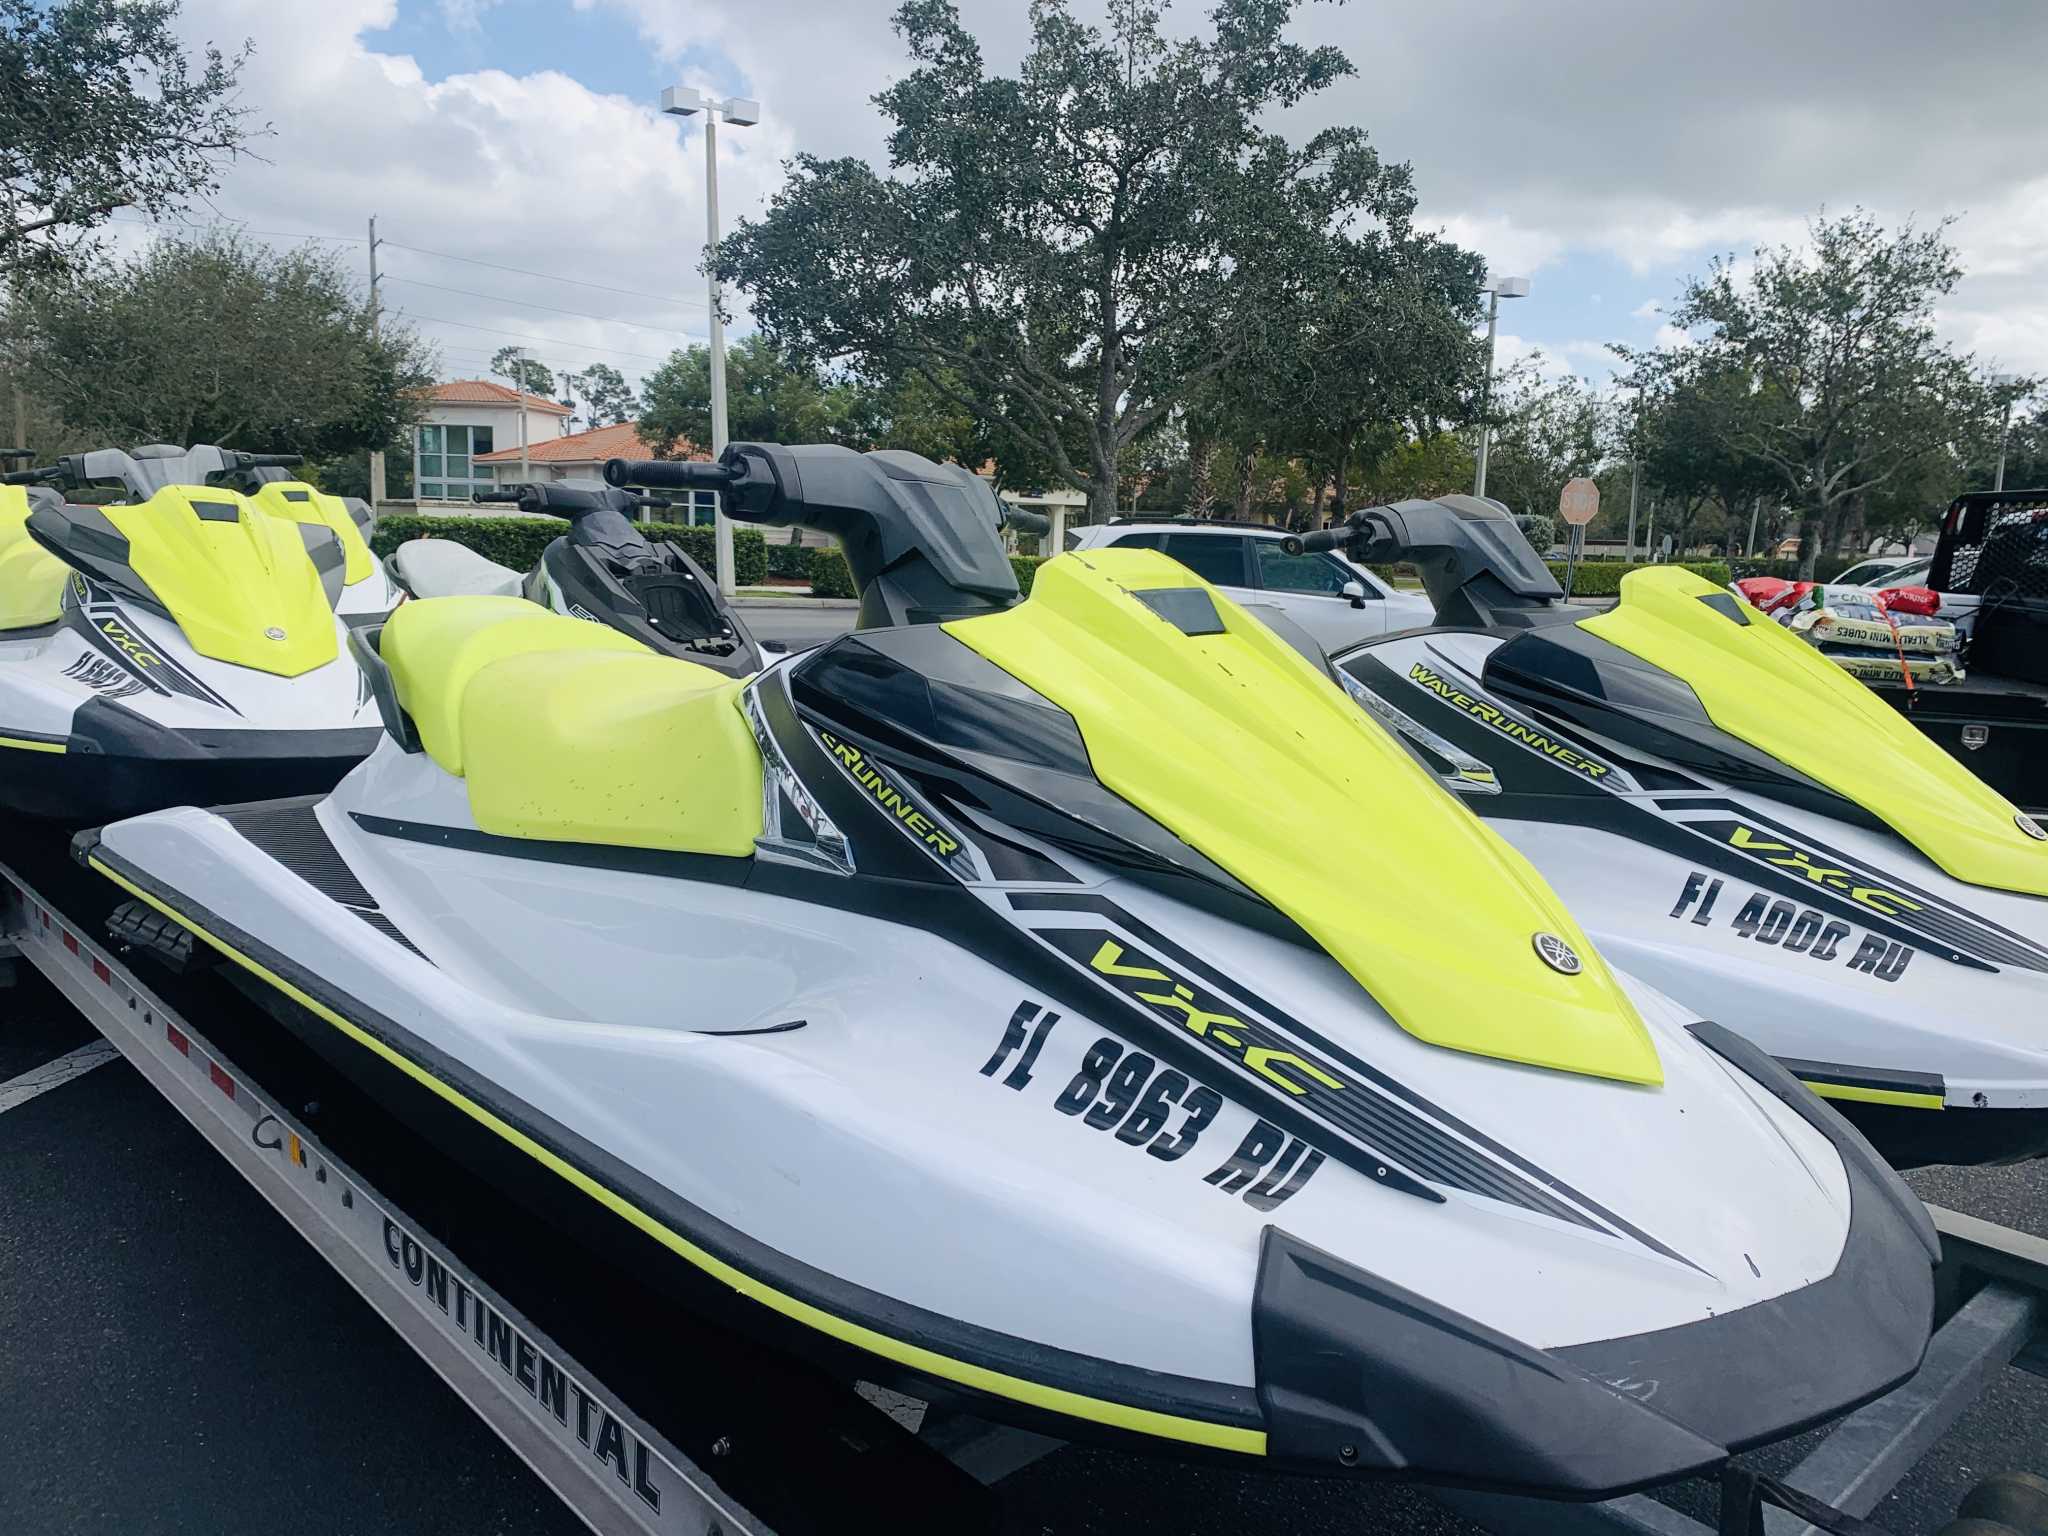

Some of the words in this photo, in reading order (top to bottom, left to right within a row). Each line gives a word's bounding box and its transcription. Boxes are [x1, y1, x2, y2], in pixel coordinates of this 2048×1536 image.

[1837, 626, 1867, 640] CUBES
[1870, 631, 1891, 643] MINI
[1669, 871, 1724, 927] FL
[1846, 933, 1914, 983] RU
[979, 999, 1061, 1091] FL
[1053, 1037, 1223, 1162] 8963
[1201, 1118, 1327, 1213] RU
[383, 1216, 660, 1516] CONTINENTAL
